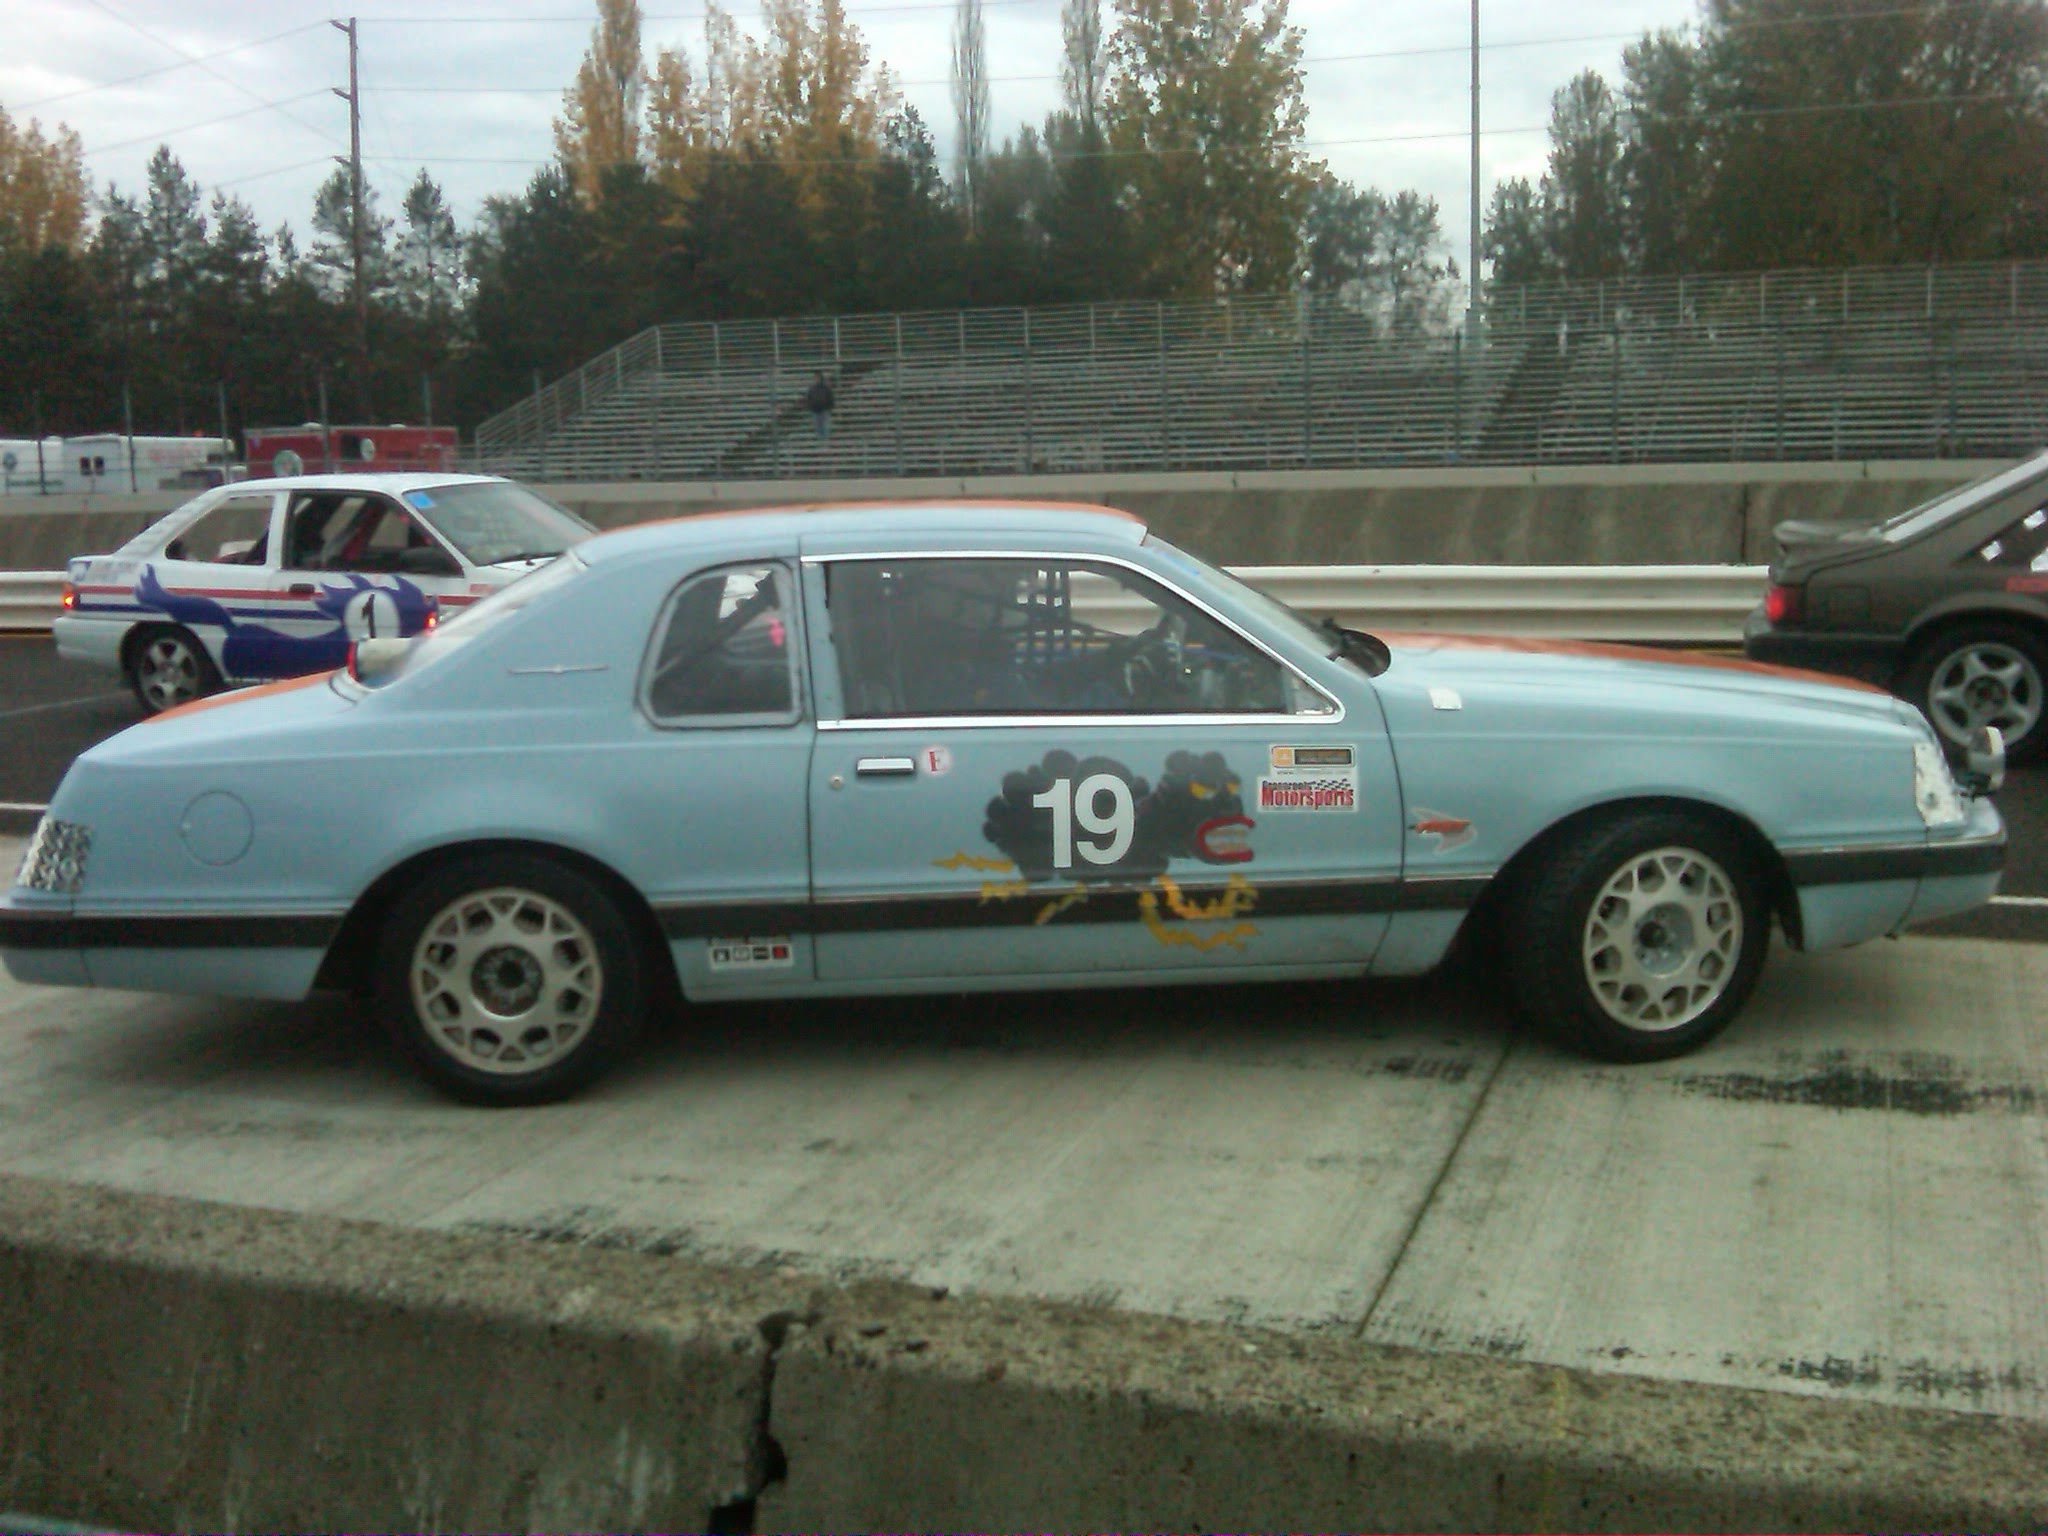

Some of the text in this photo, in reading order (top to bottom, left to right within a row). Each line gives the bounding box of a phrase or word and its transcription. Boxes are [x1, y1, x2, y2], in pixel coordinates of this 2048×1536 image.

[361, 593, 376, 639] 1
[1032, 773, 1135, 868] 19
[1261, 787, 1354, 809] Motorsports
